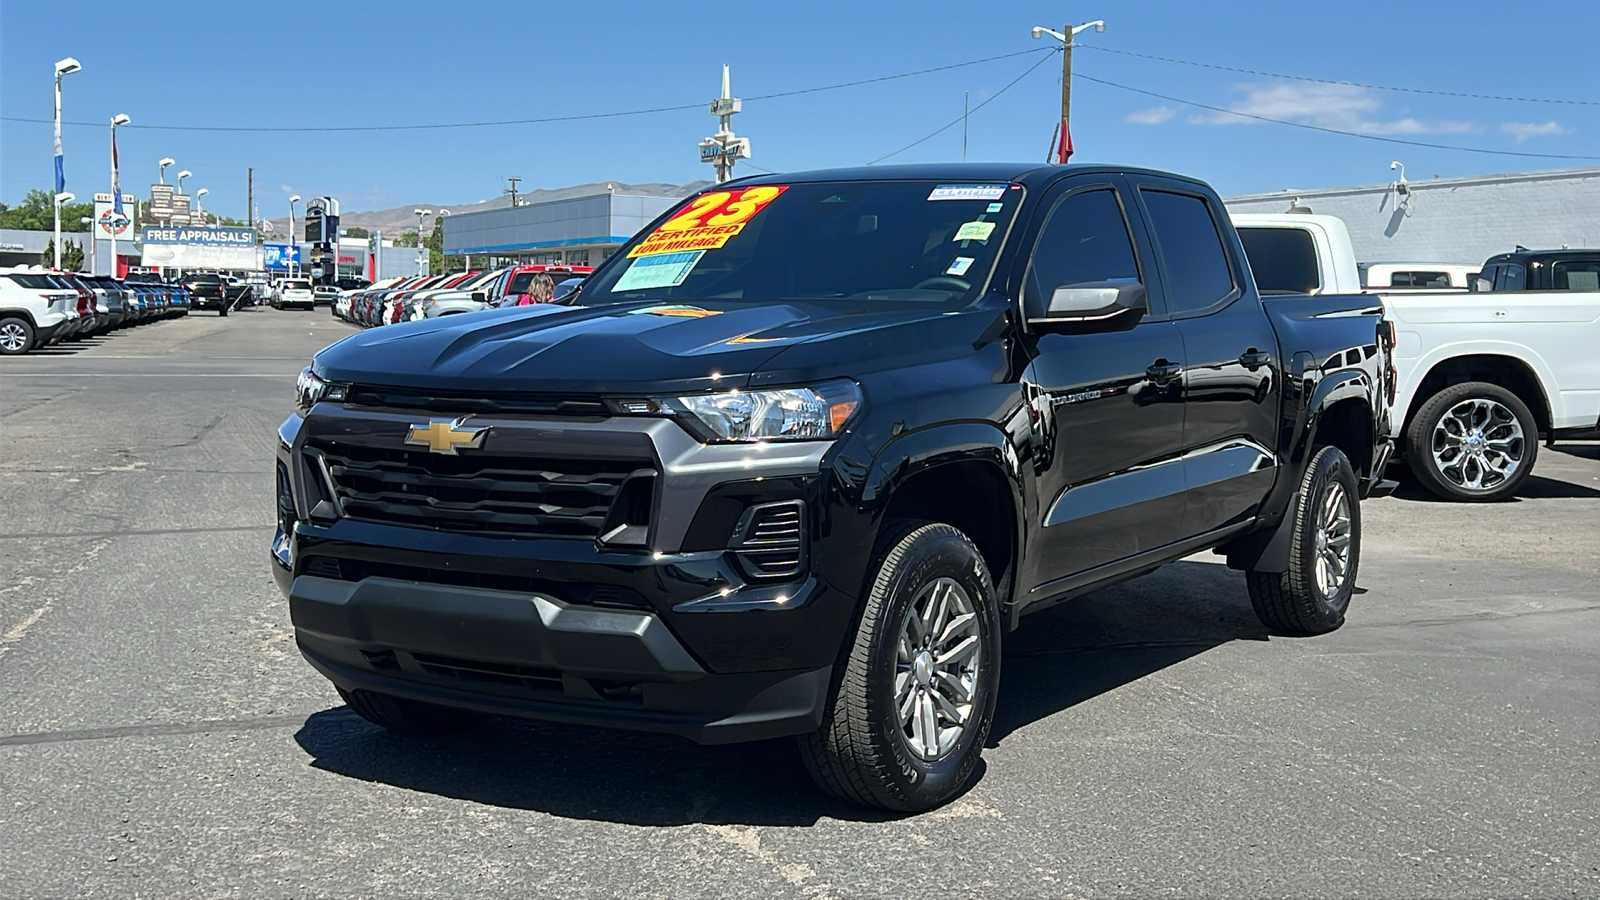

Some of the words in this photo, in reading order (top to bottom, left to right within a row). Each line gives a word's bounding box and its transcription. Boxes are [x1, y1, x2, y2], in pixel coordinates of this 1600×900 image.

[935, 188, 1000, 197] CERTIFIED
[660, 186, 780, 232] 23
[147, 230, 177, 241] FREE
[179, 231, 252, 243] APPRAISALS!
[646, 225, 739, 243] CERTIFIED
[633, 243, 665, 255] LOW
[663, 235, 722, 251] MILEAGE
